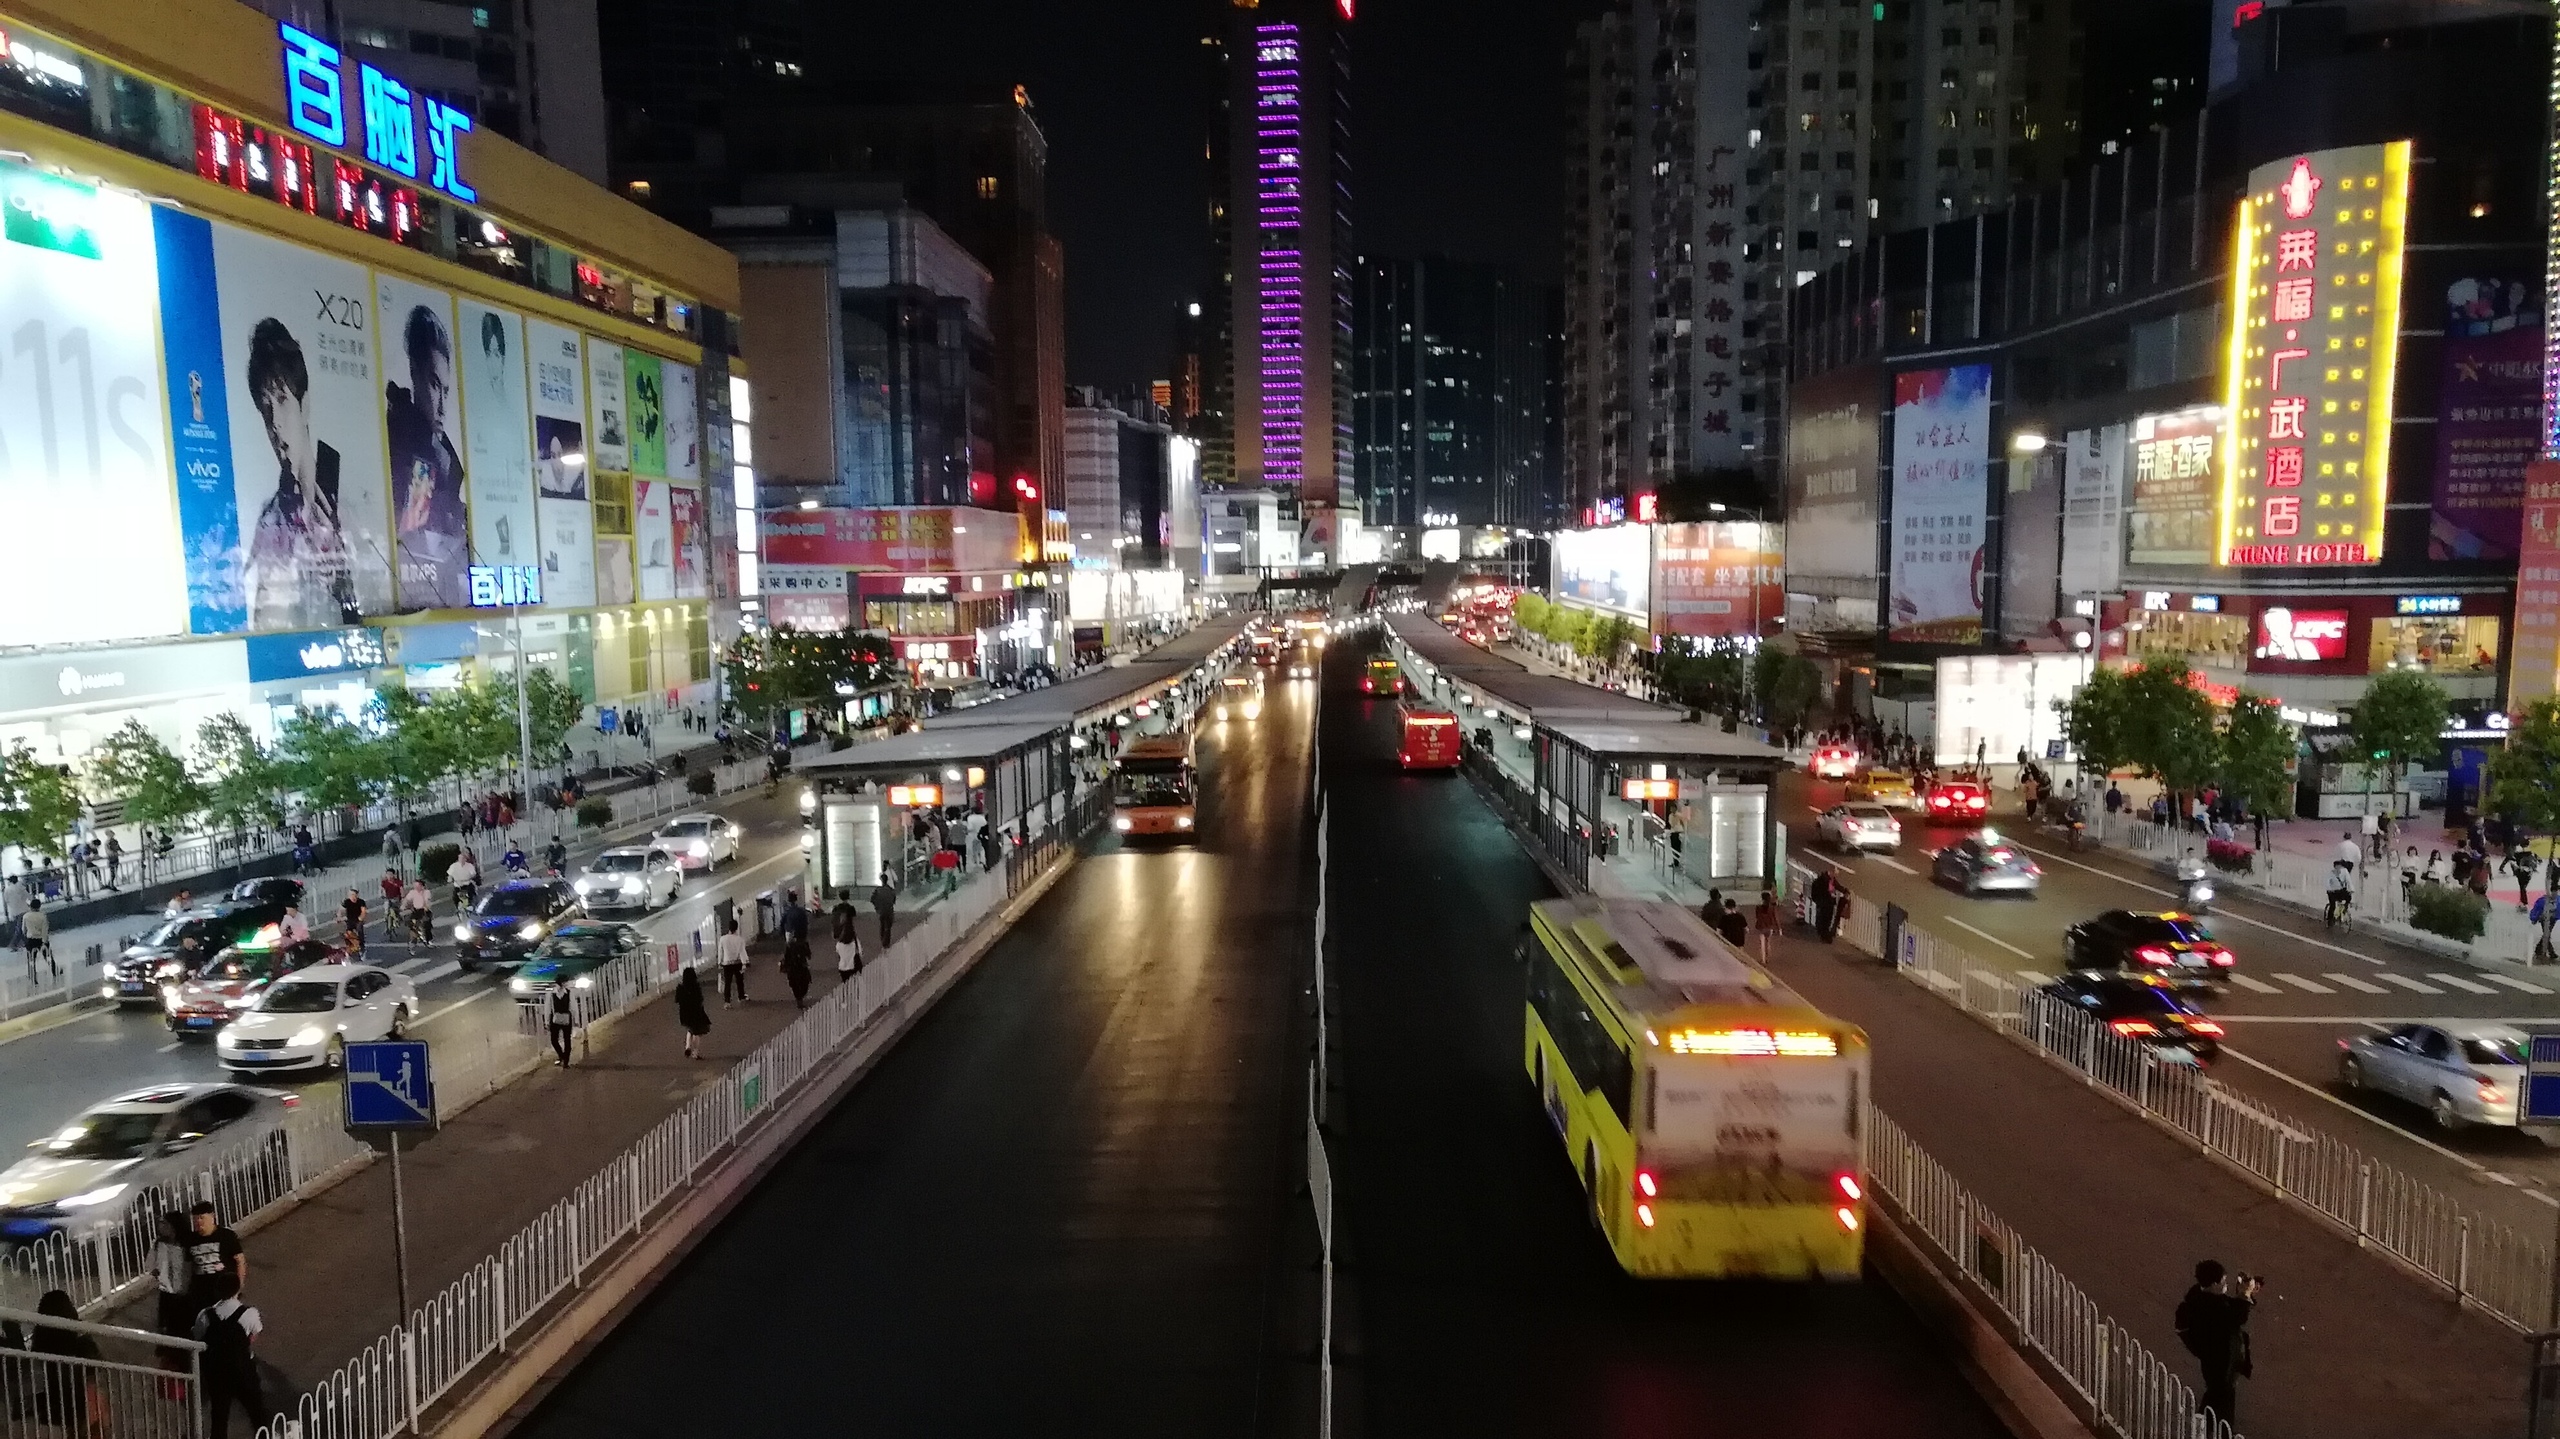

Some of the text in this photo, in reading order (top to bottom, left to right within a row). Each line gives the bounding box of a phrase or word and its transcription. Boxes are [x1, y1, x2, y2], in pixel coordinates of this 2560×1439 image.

[281, 21, 477, 204] 百脑汇
[314, 289, 364, 331] X20
[0, 318, 157, 502] 11s
[187, 459, 220, 478] vivo
[2137, 436, 2213, 482] 莱福酒家
[2296, 542, 2375, 564] HOTEL
[903, 577, 949, 594] KFC
[2144, 591, 2171, 610] KFC
[2294, 620, 2346, 638] KFC
[300, 642, 342, 670] vivo
